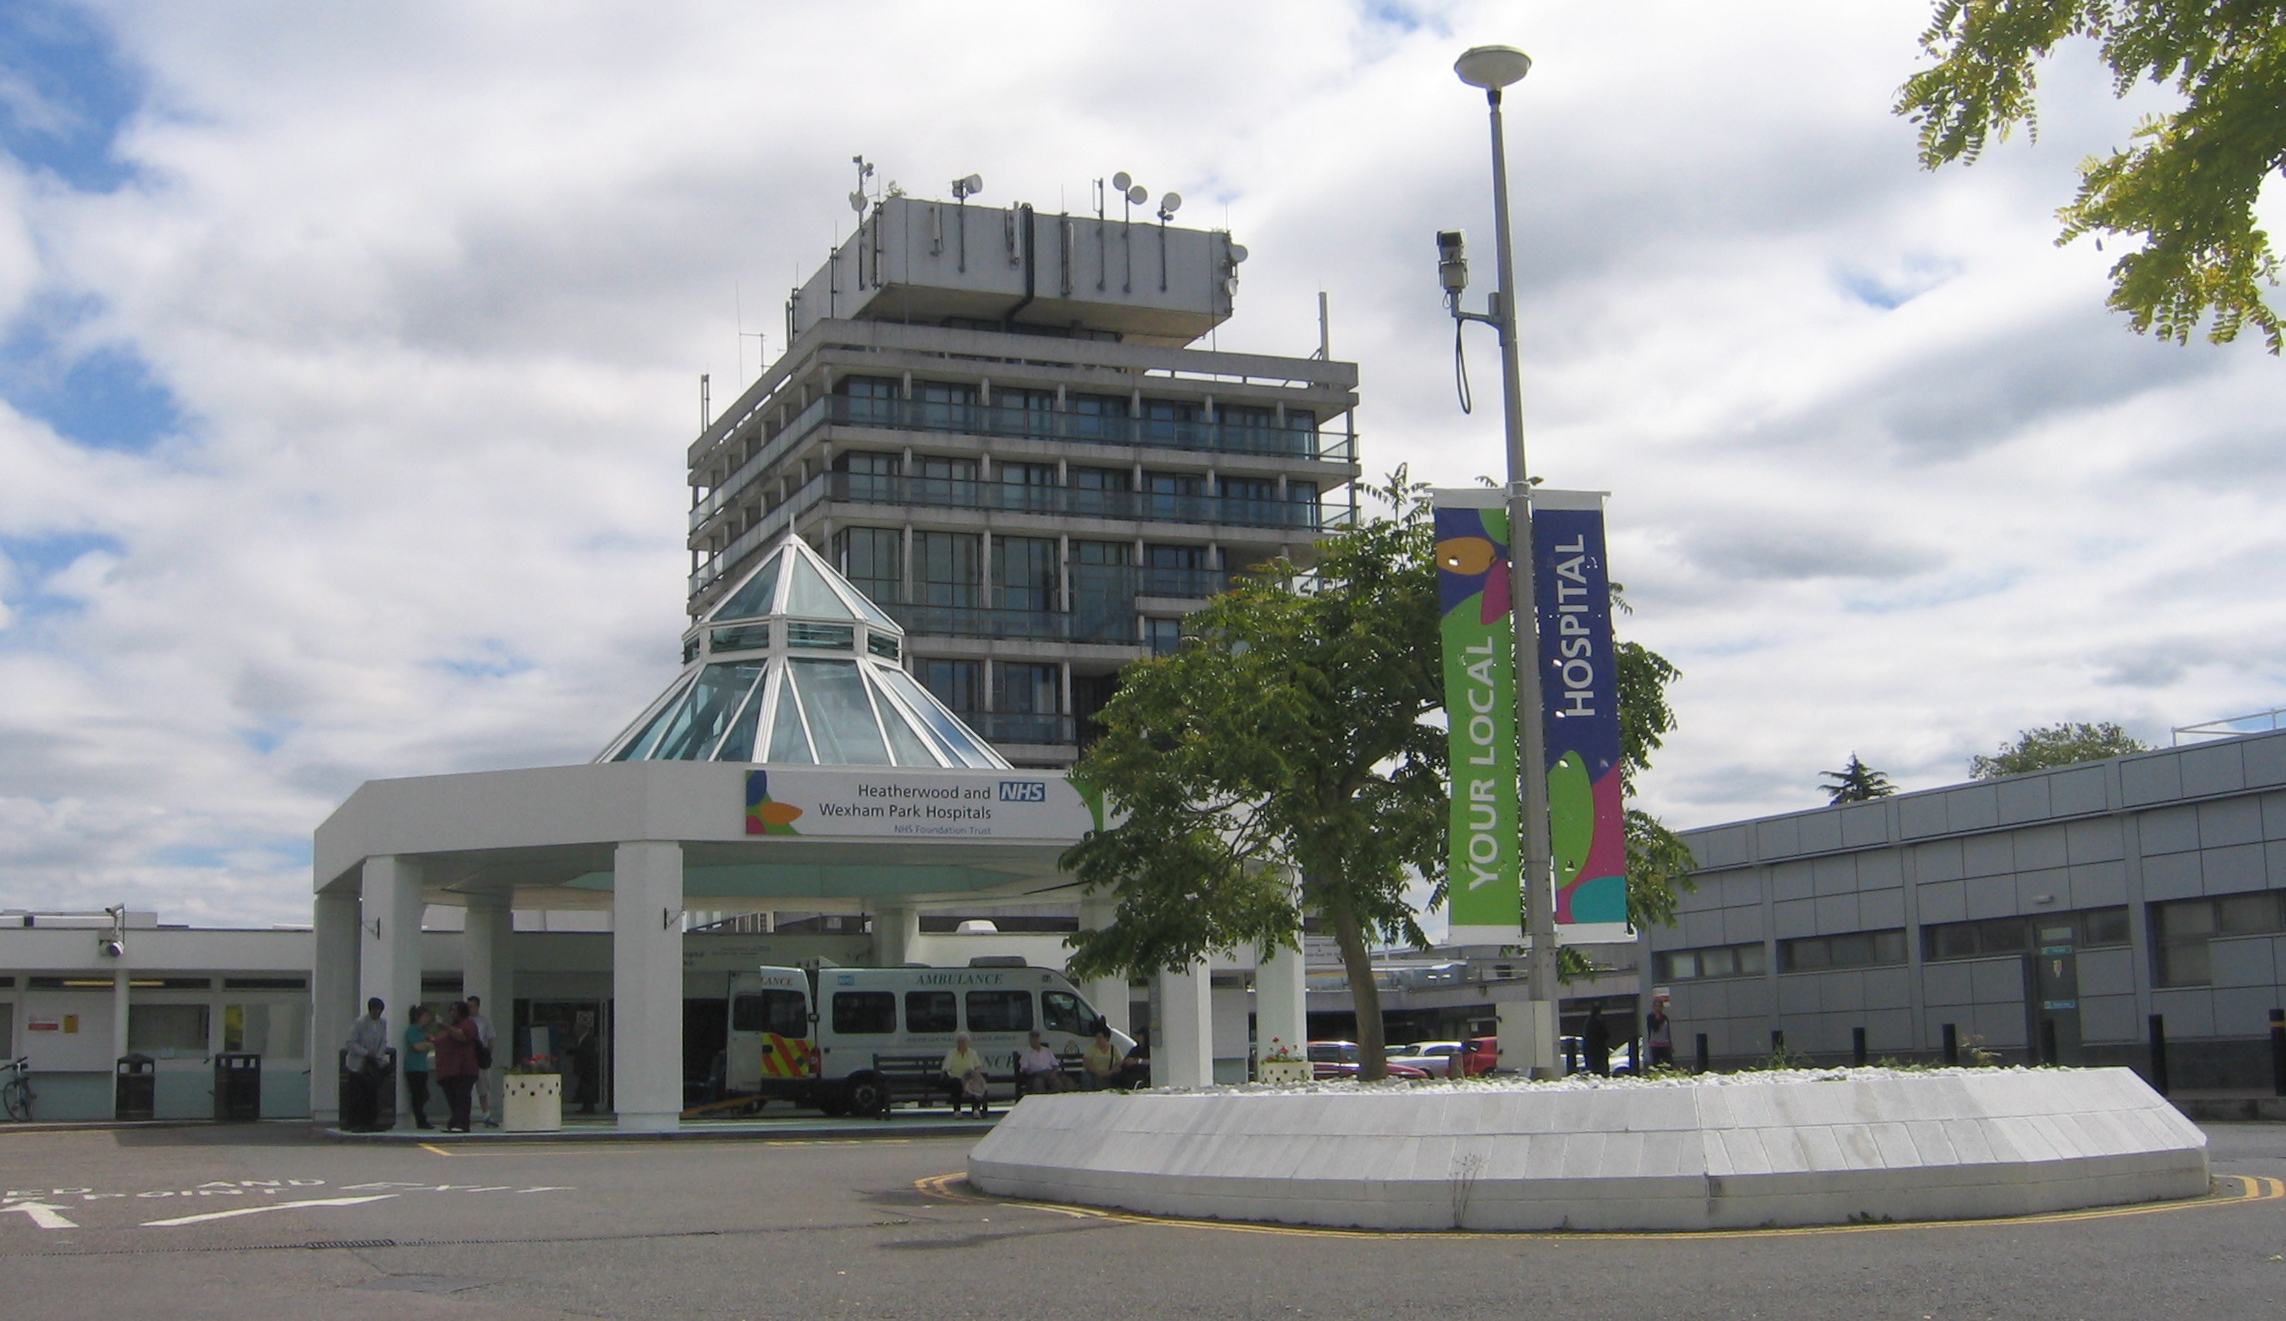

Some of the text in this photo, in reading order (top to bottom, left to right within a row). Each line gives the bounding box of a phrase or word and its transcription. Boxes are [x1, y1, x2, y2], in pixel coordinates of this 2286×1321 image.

[1553, 534, 1595, 717] HOSPITAL
[1466, 635, 1499, 891] YOUR LOCAL
[858, 784, 991, 800] Heatherwood and
[1000, 783, 1044, 801] NHS
[819, 803, 991, 821] Wexham Park Hospitals
[894, 825, 991, 835] NHS Foundation Trust
[916, 974, 1003, 985] AMBULANCE
